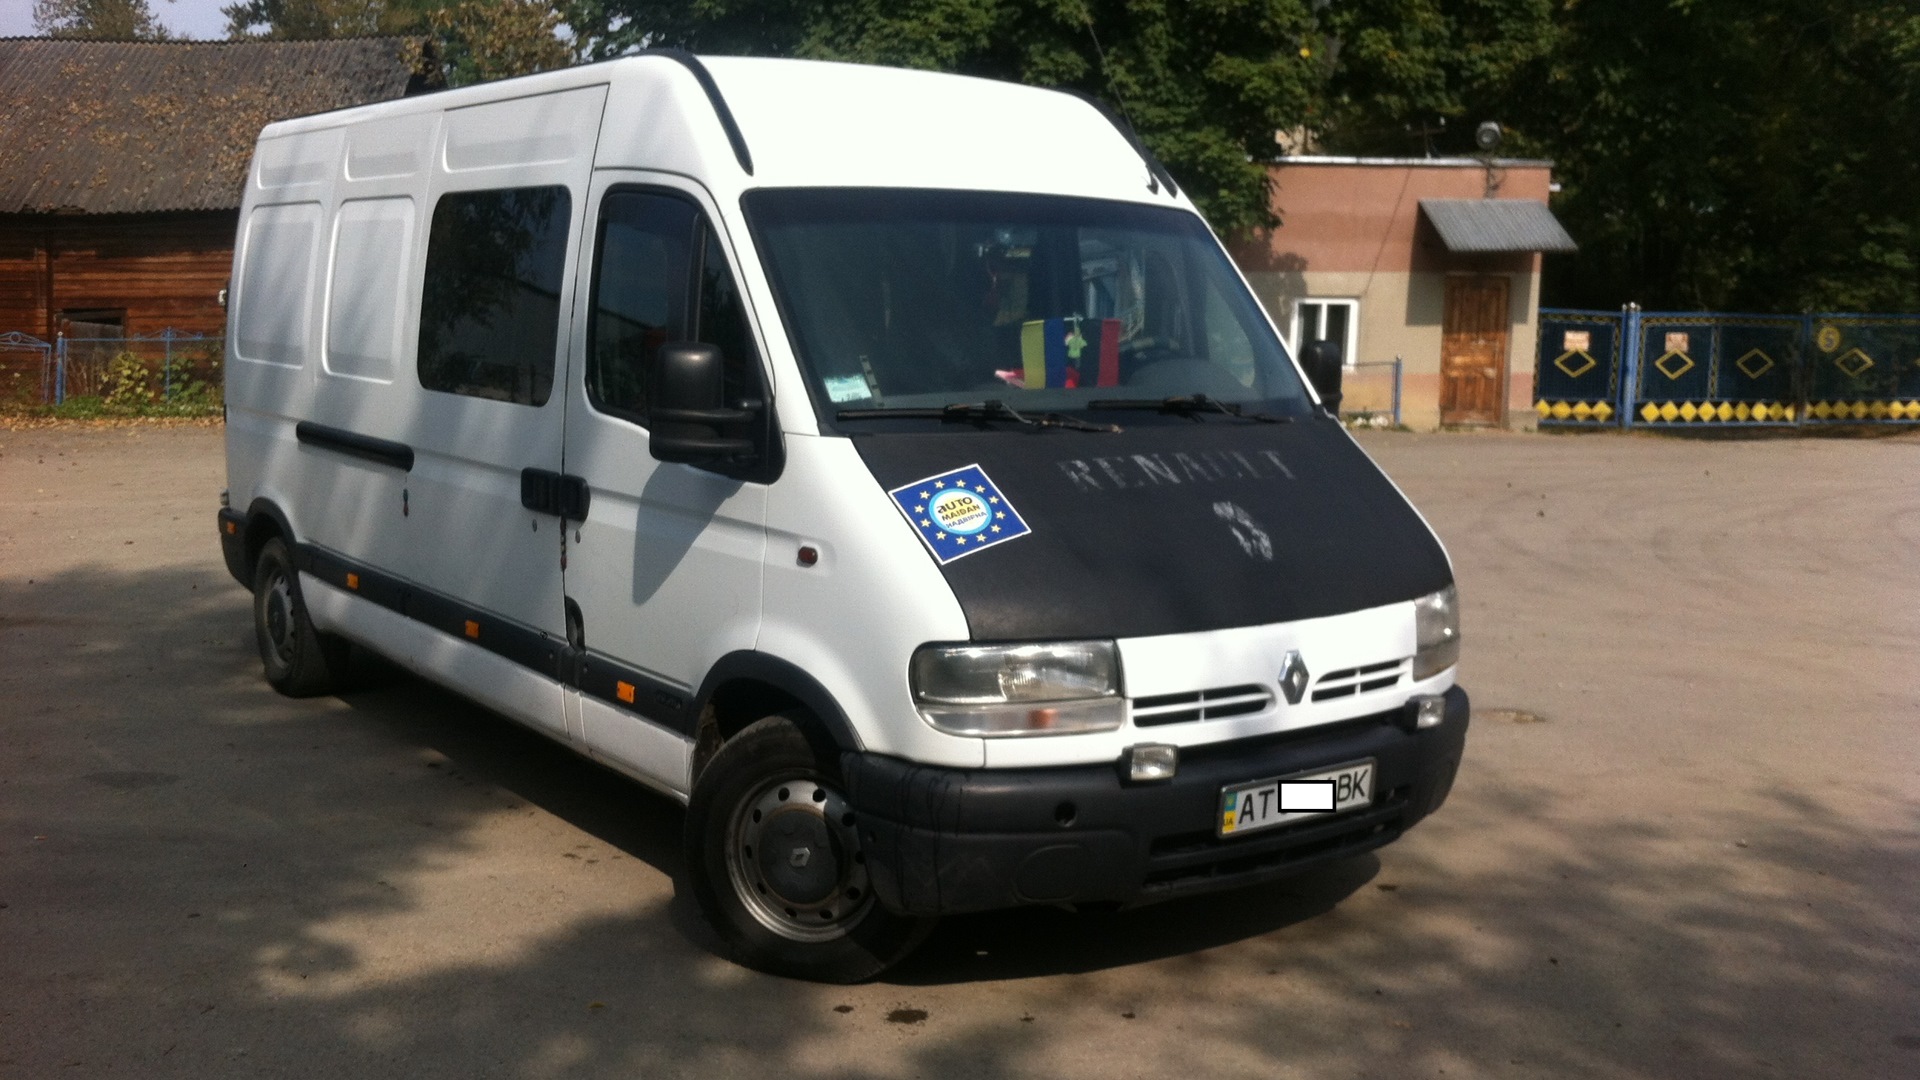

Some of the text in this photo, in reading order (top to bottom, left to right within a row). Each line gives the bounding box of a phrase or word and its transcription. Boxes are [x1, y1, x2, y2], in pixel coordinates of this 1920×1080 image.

[941, 504, 981, 521] MAIDAN
[1238, 789, 1275, 824] AT
[1337, 768, 1368, 803] BK
